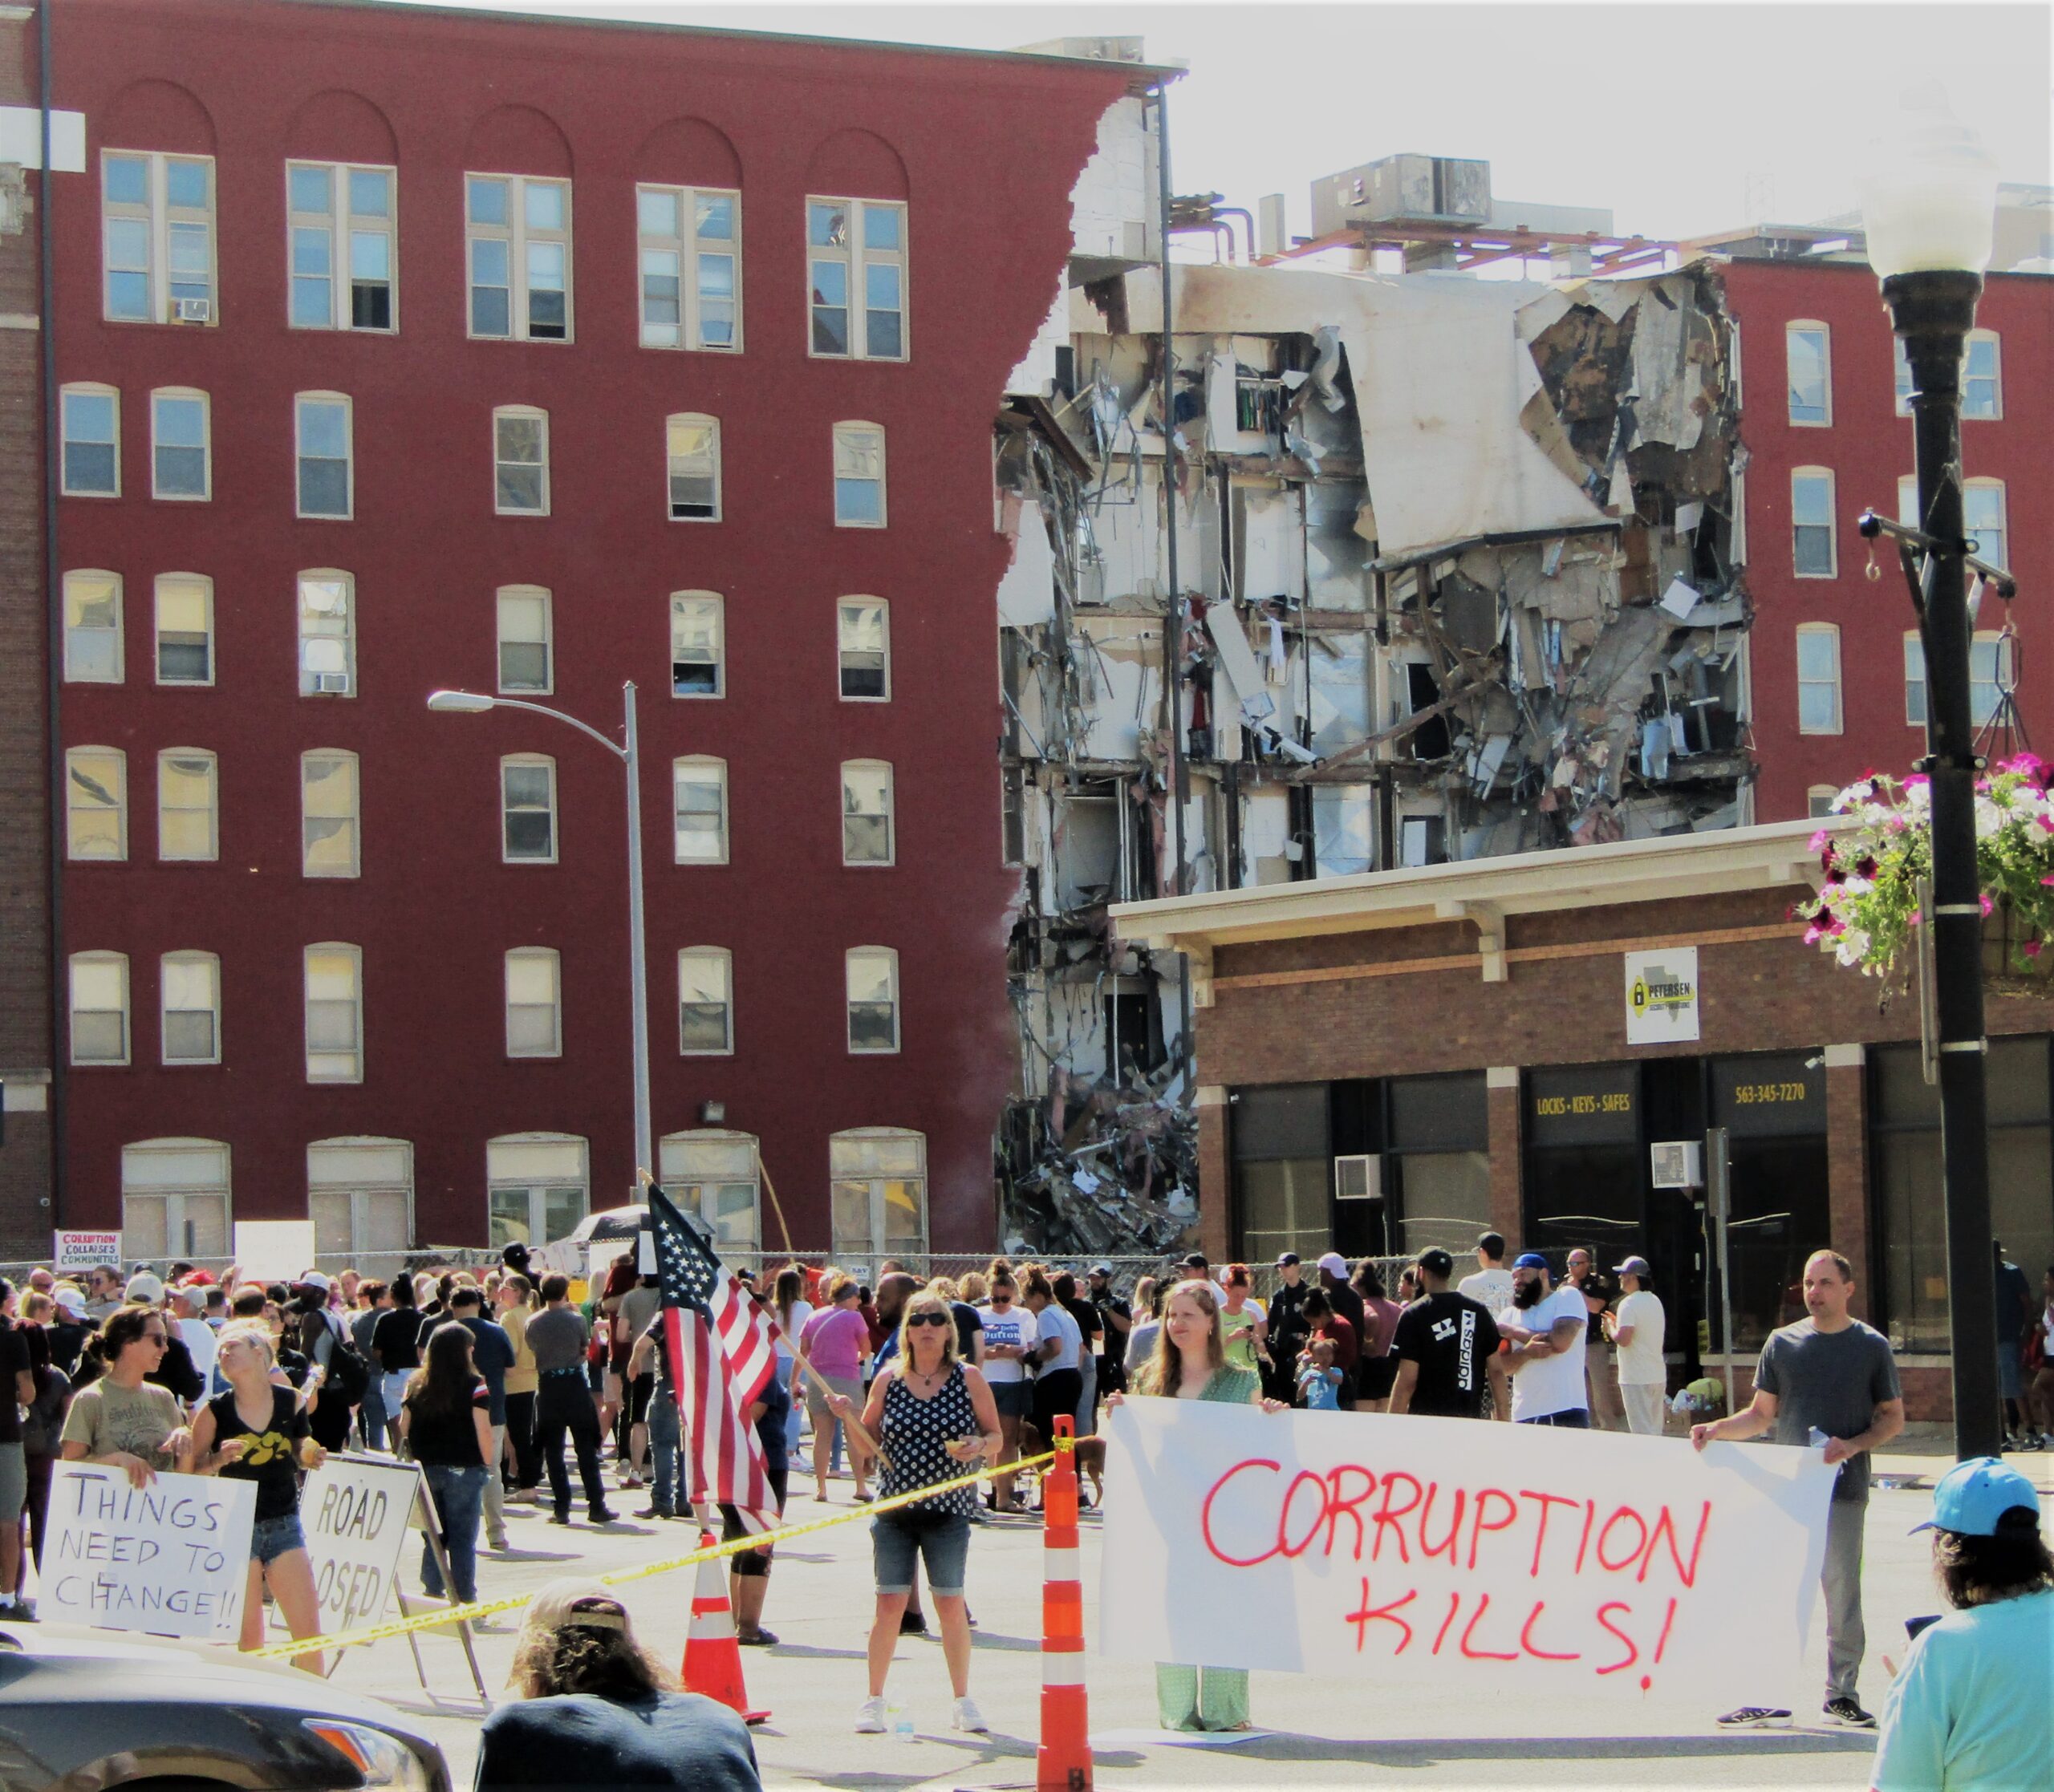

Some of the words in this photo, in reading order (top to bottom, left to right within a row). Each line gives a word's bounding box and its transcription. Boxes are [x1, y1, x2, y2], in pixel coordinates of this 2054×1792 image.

[1648, 982, 1691, 998] PETERSEN
[1537, 1097, 1565, 1115] LOCKS
[1572, 1095, 1596, 1113] KEYS
[1601, 1093, 1630, 1112] SAFES
[1735, 1083, 1805, 1104] 563-345-7270
[66, 1245, 116, 1255] COLLAPSES
[1457, 1328, 1474, 1390] adidas
[63, 1472, 224, 1531] THINGS
[317, 1483, 388, 1541] ROAD
[1203, 1459, 1711, 1587] CORRUPTION
[60, 1529, 160, 1565] NEED
[185, 1542, 225, 1573] TO
[55, 1572, 237, 1629] CHANGE!!
[311, 1556, 381, 1617] OSED
[1346, 1577, 1677, 1697] KILLS!
